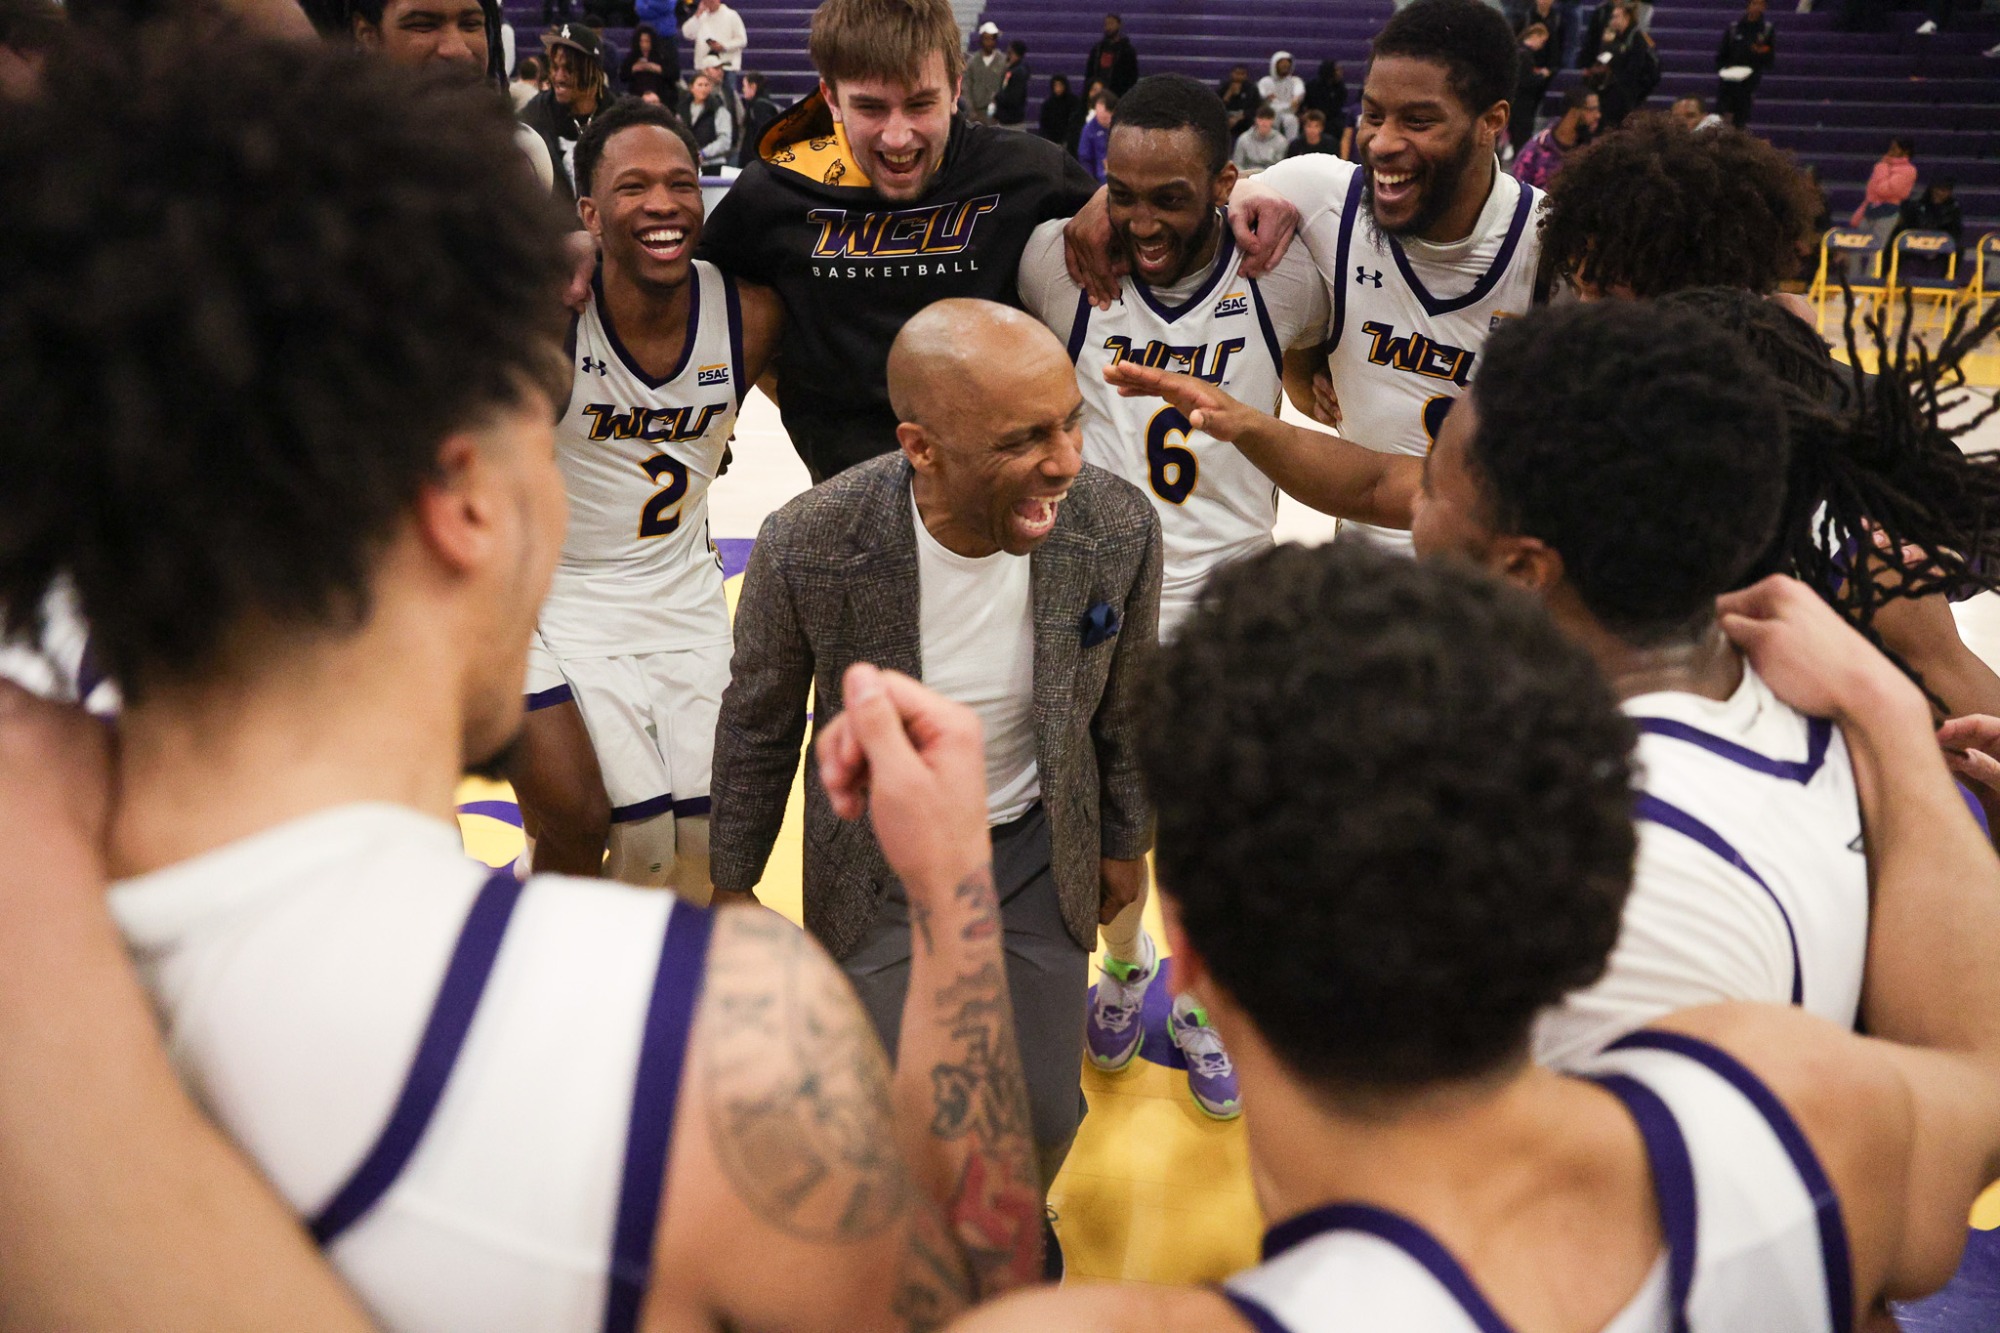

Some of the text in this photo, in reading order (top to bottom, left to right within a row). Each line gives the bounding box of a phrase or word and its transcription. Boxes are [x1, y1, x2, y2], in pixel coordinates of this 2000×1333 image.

[807, 194, 1000, 258] WCU
[812, 260, 978, 278] BASKETBALL
[1215, 296, 1247, 313] PSAC
[698, 367, 728, 381] PSAC
[582, 402, 728, 443] WCU
[1144, 403, 1199, 506] 6
[637, 451, 691, 540] 2
